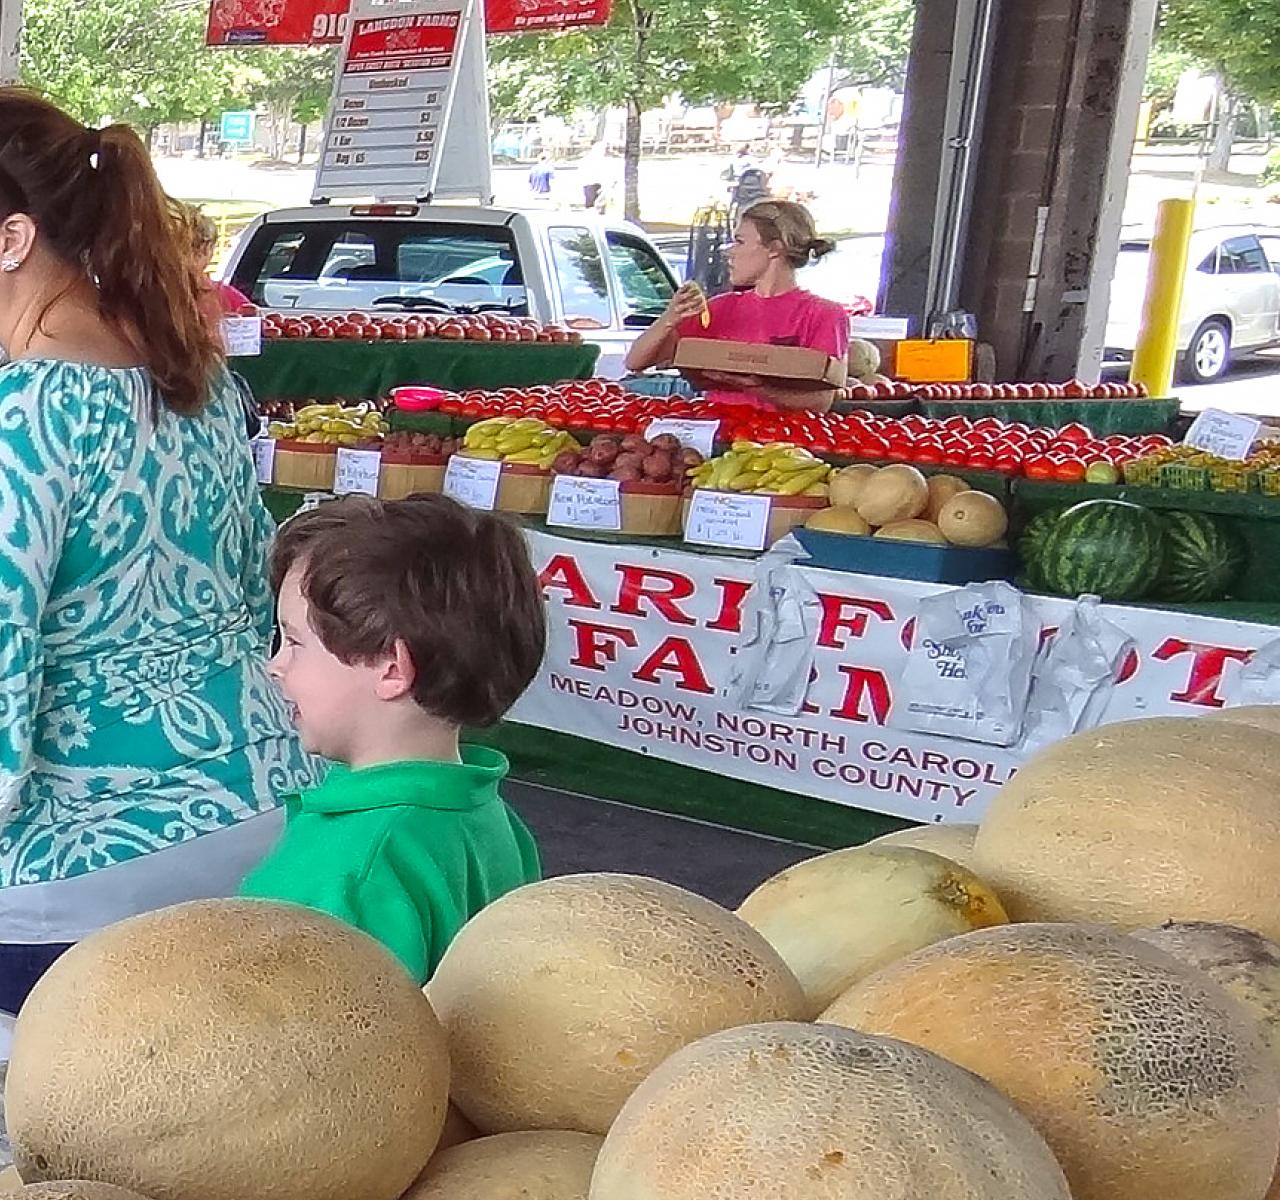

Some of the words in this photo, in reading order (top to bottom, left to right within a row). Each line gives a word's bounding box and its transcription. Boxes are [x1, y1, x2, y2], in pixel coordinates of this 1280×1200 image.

[359, 17, 415, 36] LANGDON
[416, 13, 459, 28] FARMS
[550, 673, 705, 728] MEADOW,
[717, 711, 846, 755] NORTH
[617, 713, 798, 771] JOHNSTON
[813, 759, 977, 808] COUNTY
